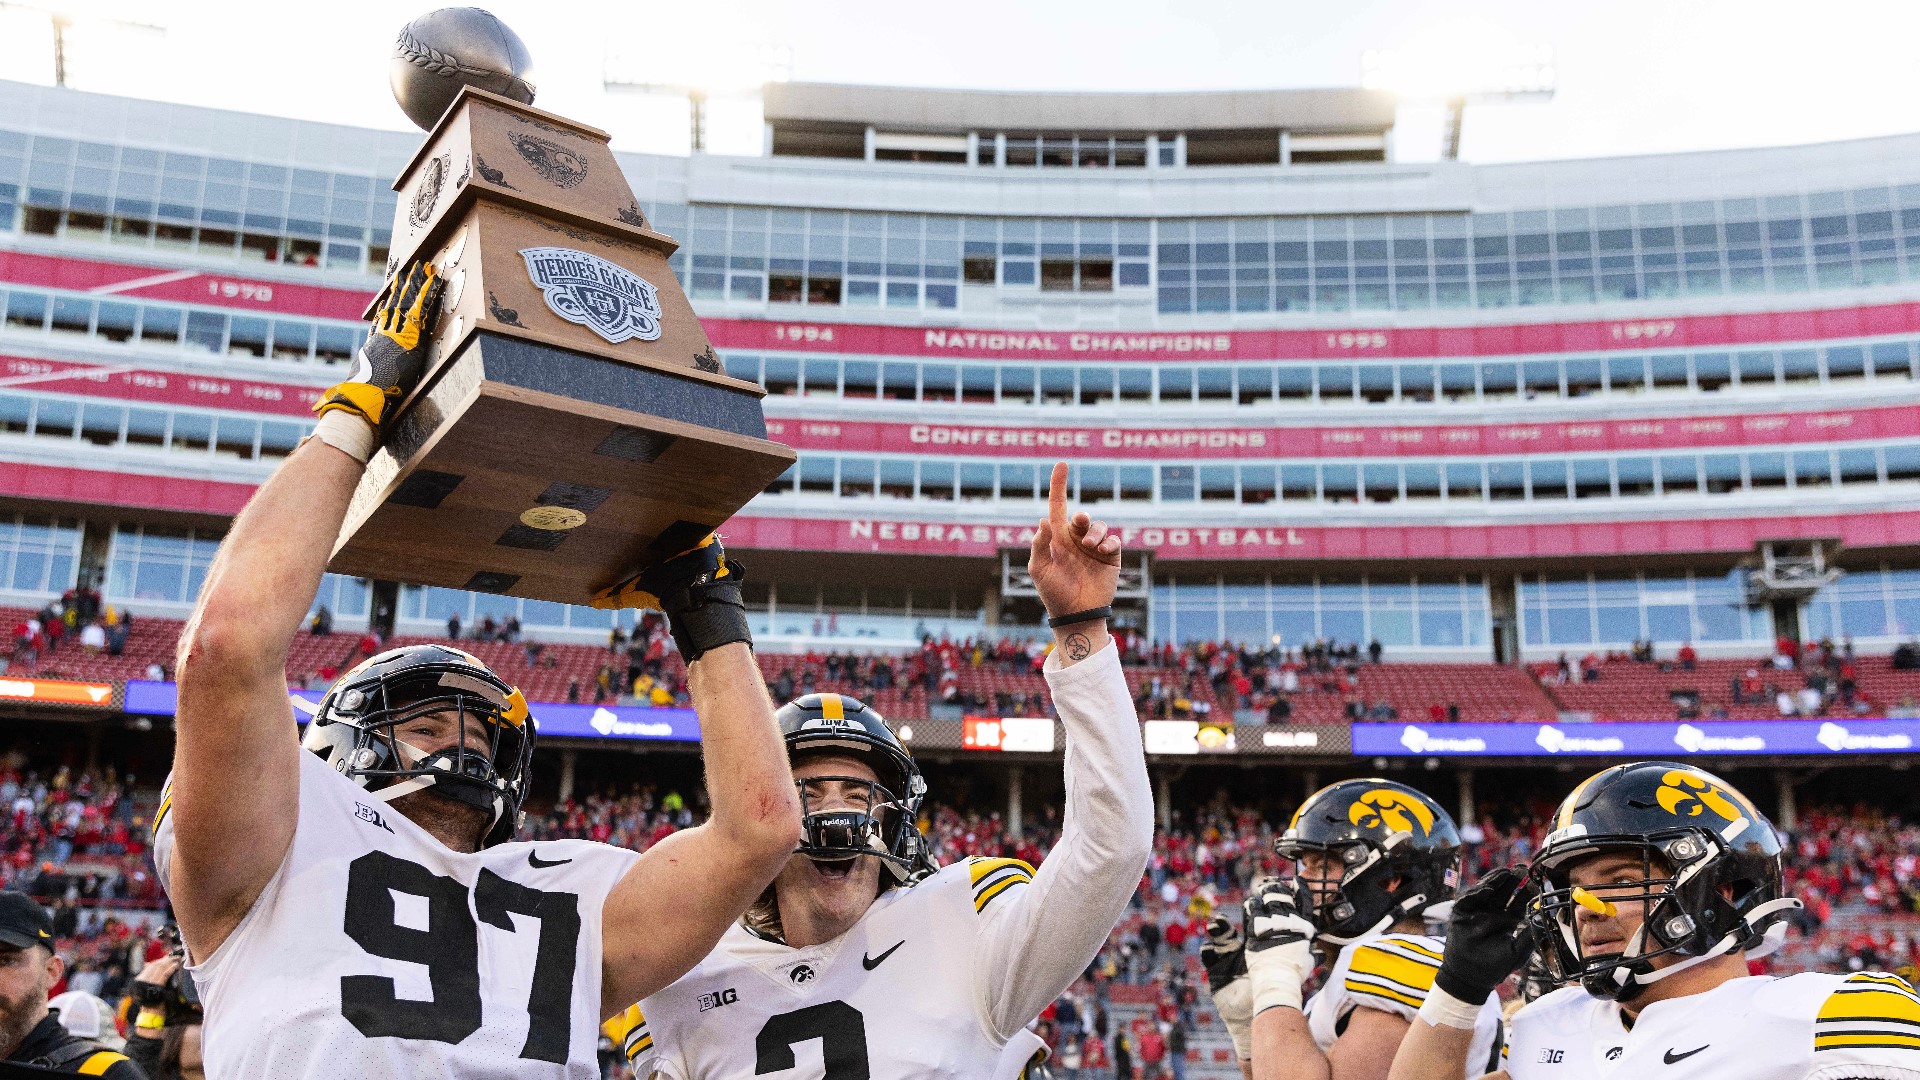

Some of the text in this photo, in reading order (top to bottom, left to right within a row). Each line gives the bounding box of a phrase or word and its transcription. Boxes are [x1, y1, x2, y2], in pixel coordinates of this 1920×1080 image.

[209, 281, 273, 302] 1970
[534, 258, 598, 284] HEROES
[600, 267, 654, 312] GAME
[629, 314, 648, 330] N
[775, 326, 834, 342] 1994
[924, 330, 1059, 351] NATIONAL
[1069, 333, 1231, 352] CHAMPIONS
[1612, 320, 1676, 340] 1997
[909, 424, 1089, 448] CONFERENCE
[1102, 428, 1267, 449] CHAMPIONS
[849, 519, 1306, 547] NEBRASKA FOOTBALL
[820, 719, 850, 728] IOWA
[341, 850, 581, 1066] 97
